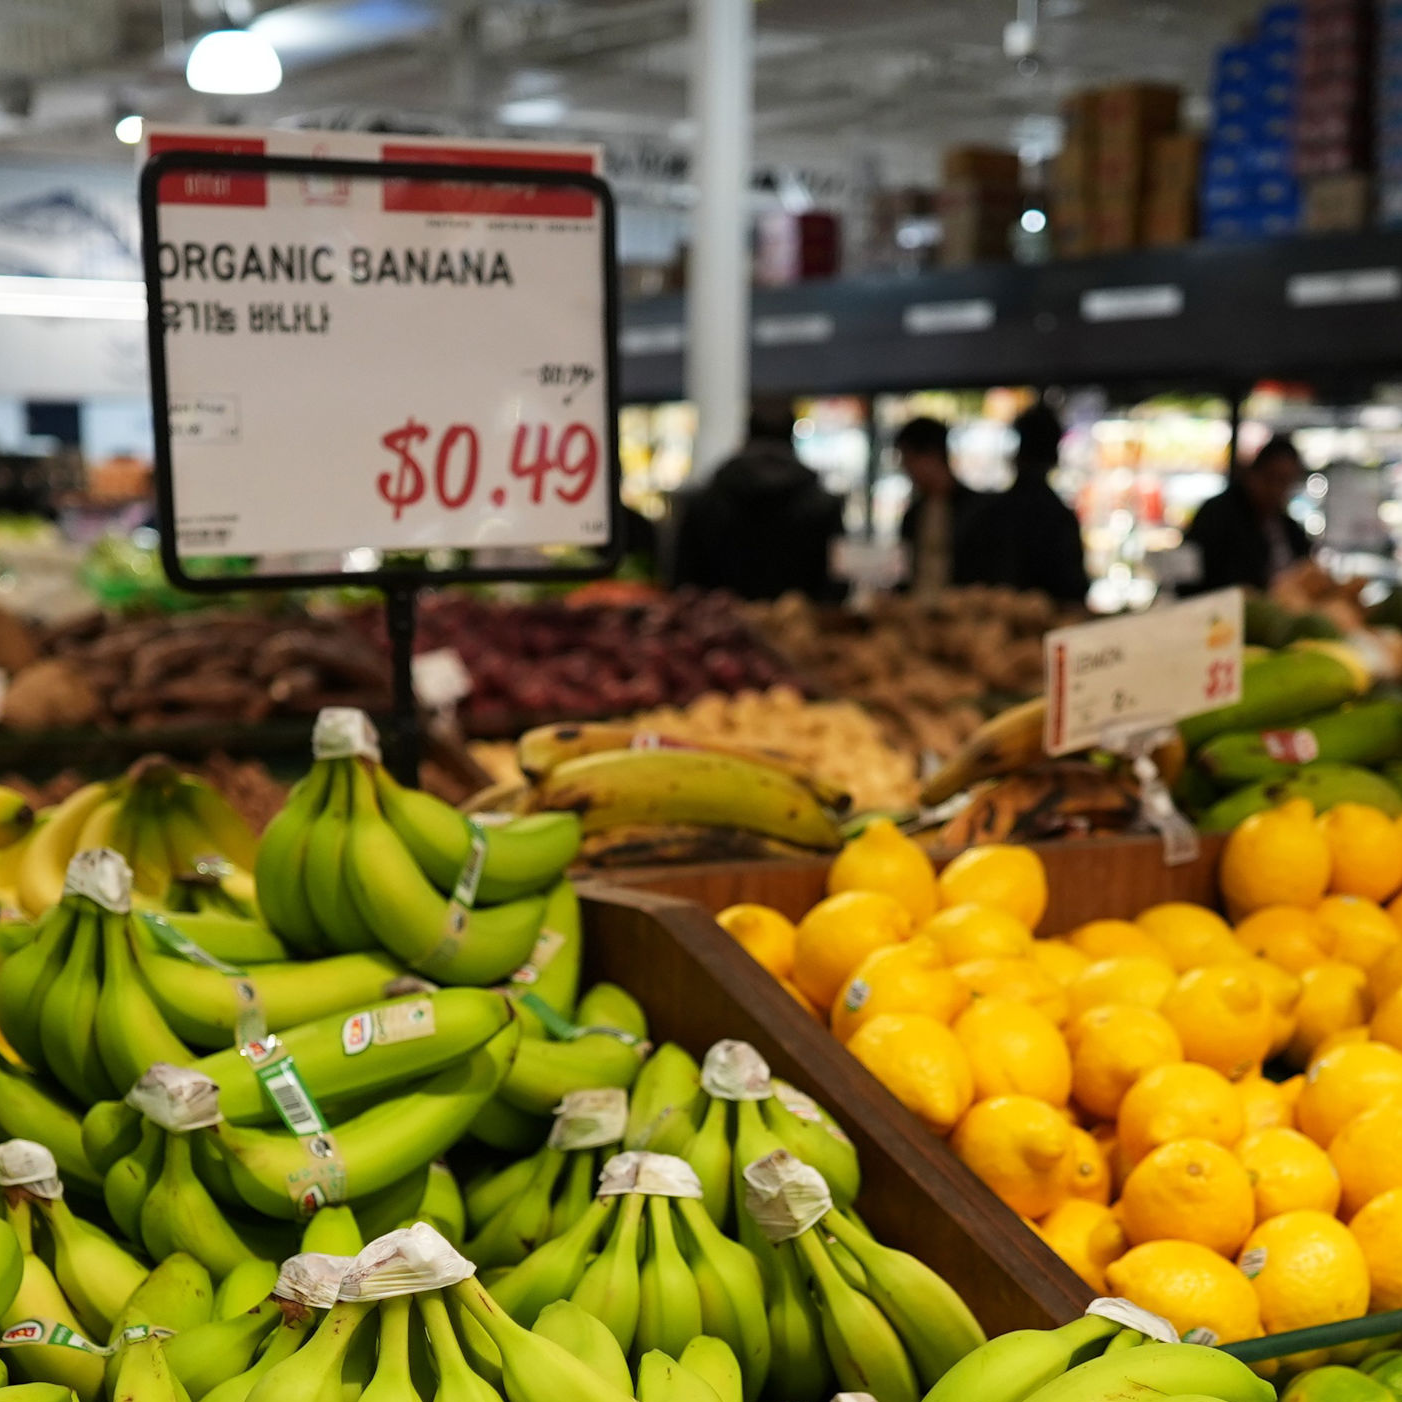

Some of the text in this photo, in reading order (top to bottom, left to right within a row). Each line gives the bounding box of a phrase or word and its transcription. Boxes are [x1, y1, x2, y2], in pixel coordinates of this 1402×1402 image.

[158, 243, 514, 287] ORGANIC BANANA
[248, 302, 330, 337] 바나나
[377, 416, 599, 521] $0.49
